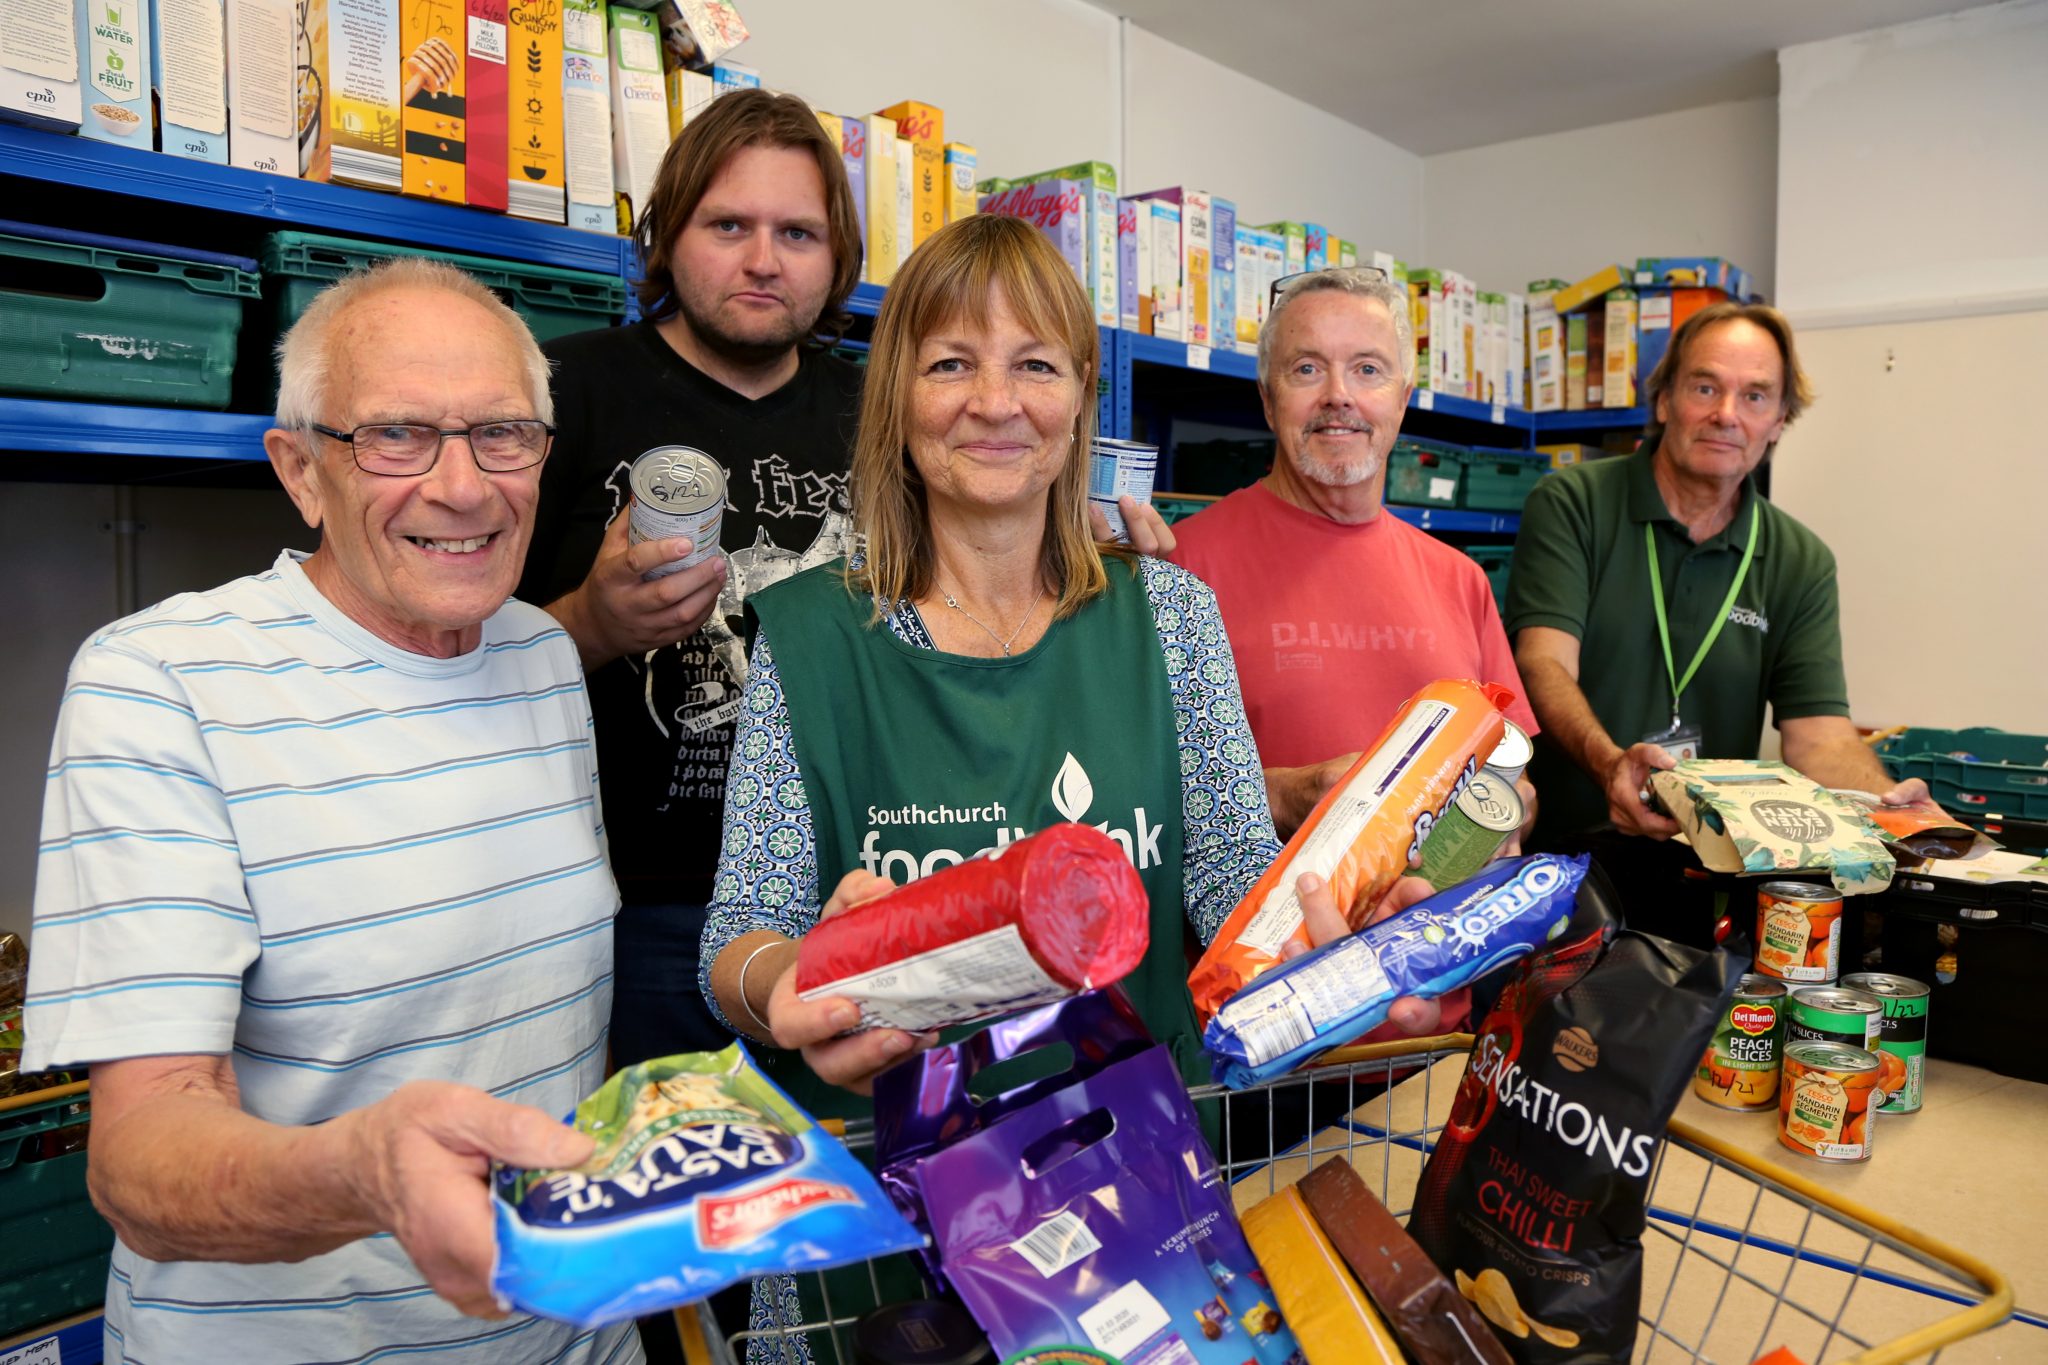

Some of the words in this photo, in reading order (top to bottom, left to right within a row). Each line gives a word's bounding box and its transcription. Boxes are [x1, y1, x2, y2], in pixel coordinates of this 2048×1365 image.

[95, 26, 133, 46] WATER
[526, 24, 546, 34] NUT
[477, 35, 498, 46] CHOCO
[98, 73, 134, 90] FRUIT
[1424, 758, 1452, 792] GINGER
[1405, 792, 1426, 816] NUTS
[1756, 807, 1819, 817] PATH
[868, 802, 1006, 825] Southchurch
[1764, 816, 1826, 828] EATEN
[1462, 864, 1559, 936] OREO
[1768, 923, 1804, 940] MANDARIN
[1776, 919, 1798, 929] TESCO
[1766, 929, 1802, 946] SEGMENTS
[1734, 1012, 1748, 1020] Del
[1750, 1014, 1774, 1022] Monte
[1798, 1028, 1824, 1040] SLICES
[1558, 1034, 1598, 1062] WALKERS
[1730, 1037, 1773, 1050] PEACH
[1730, 1048, 1772, 1062] SLICES
[1732, 1061, 1754, 1069] LIGHT
[1798, 1094, 1840, 1114] MANDARIN
[1808, 1089, 1833, 1102] TESCO
[1472, 1033, 1654, 1177] SENSATIONS
[1796, 1100, 1838, 1121] SEGMENTS
[626, 1144, 782, 1198] PASTA
[1488, 1146, 1525, 1188] THAI
[1526, 1176, 1593, 1218] SWEET
[1478, 1180, 1575, 1253] CHILLI
[1174, 1241, 1188, 1253] OF
[1542, 1268, 1592, 1286] CRISPS
